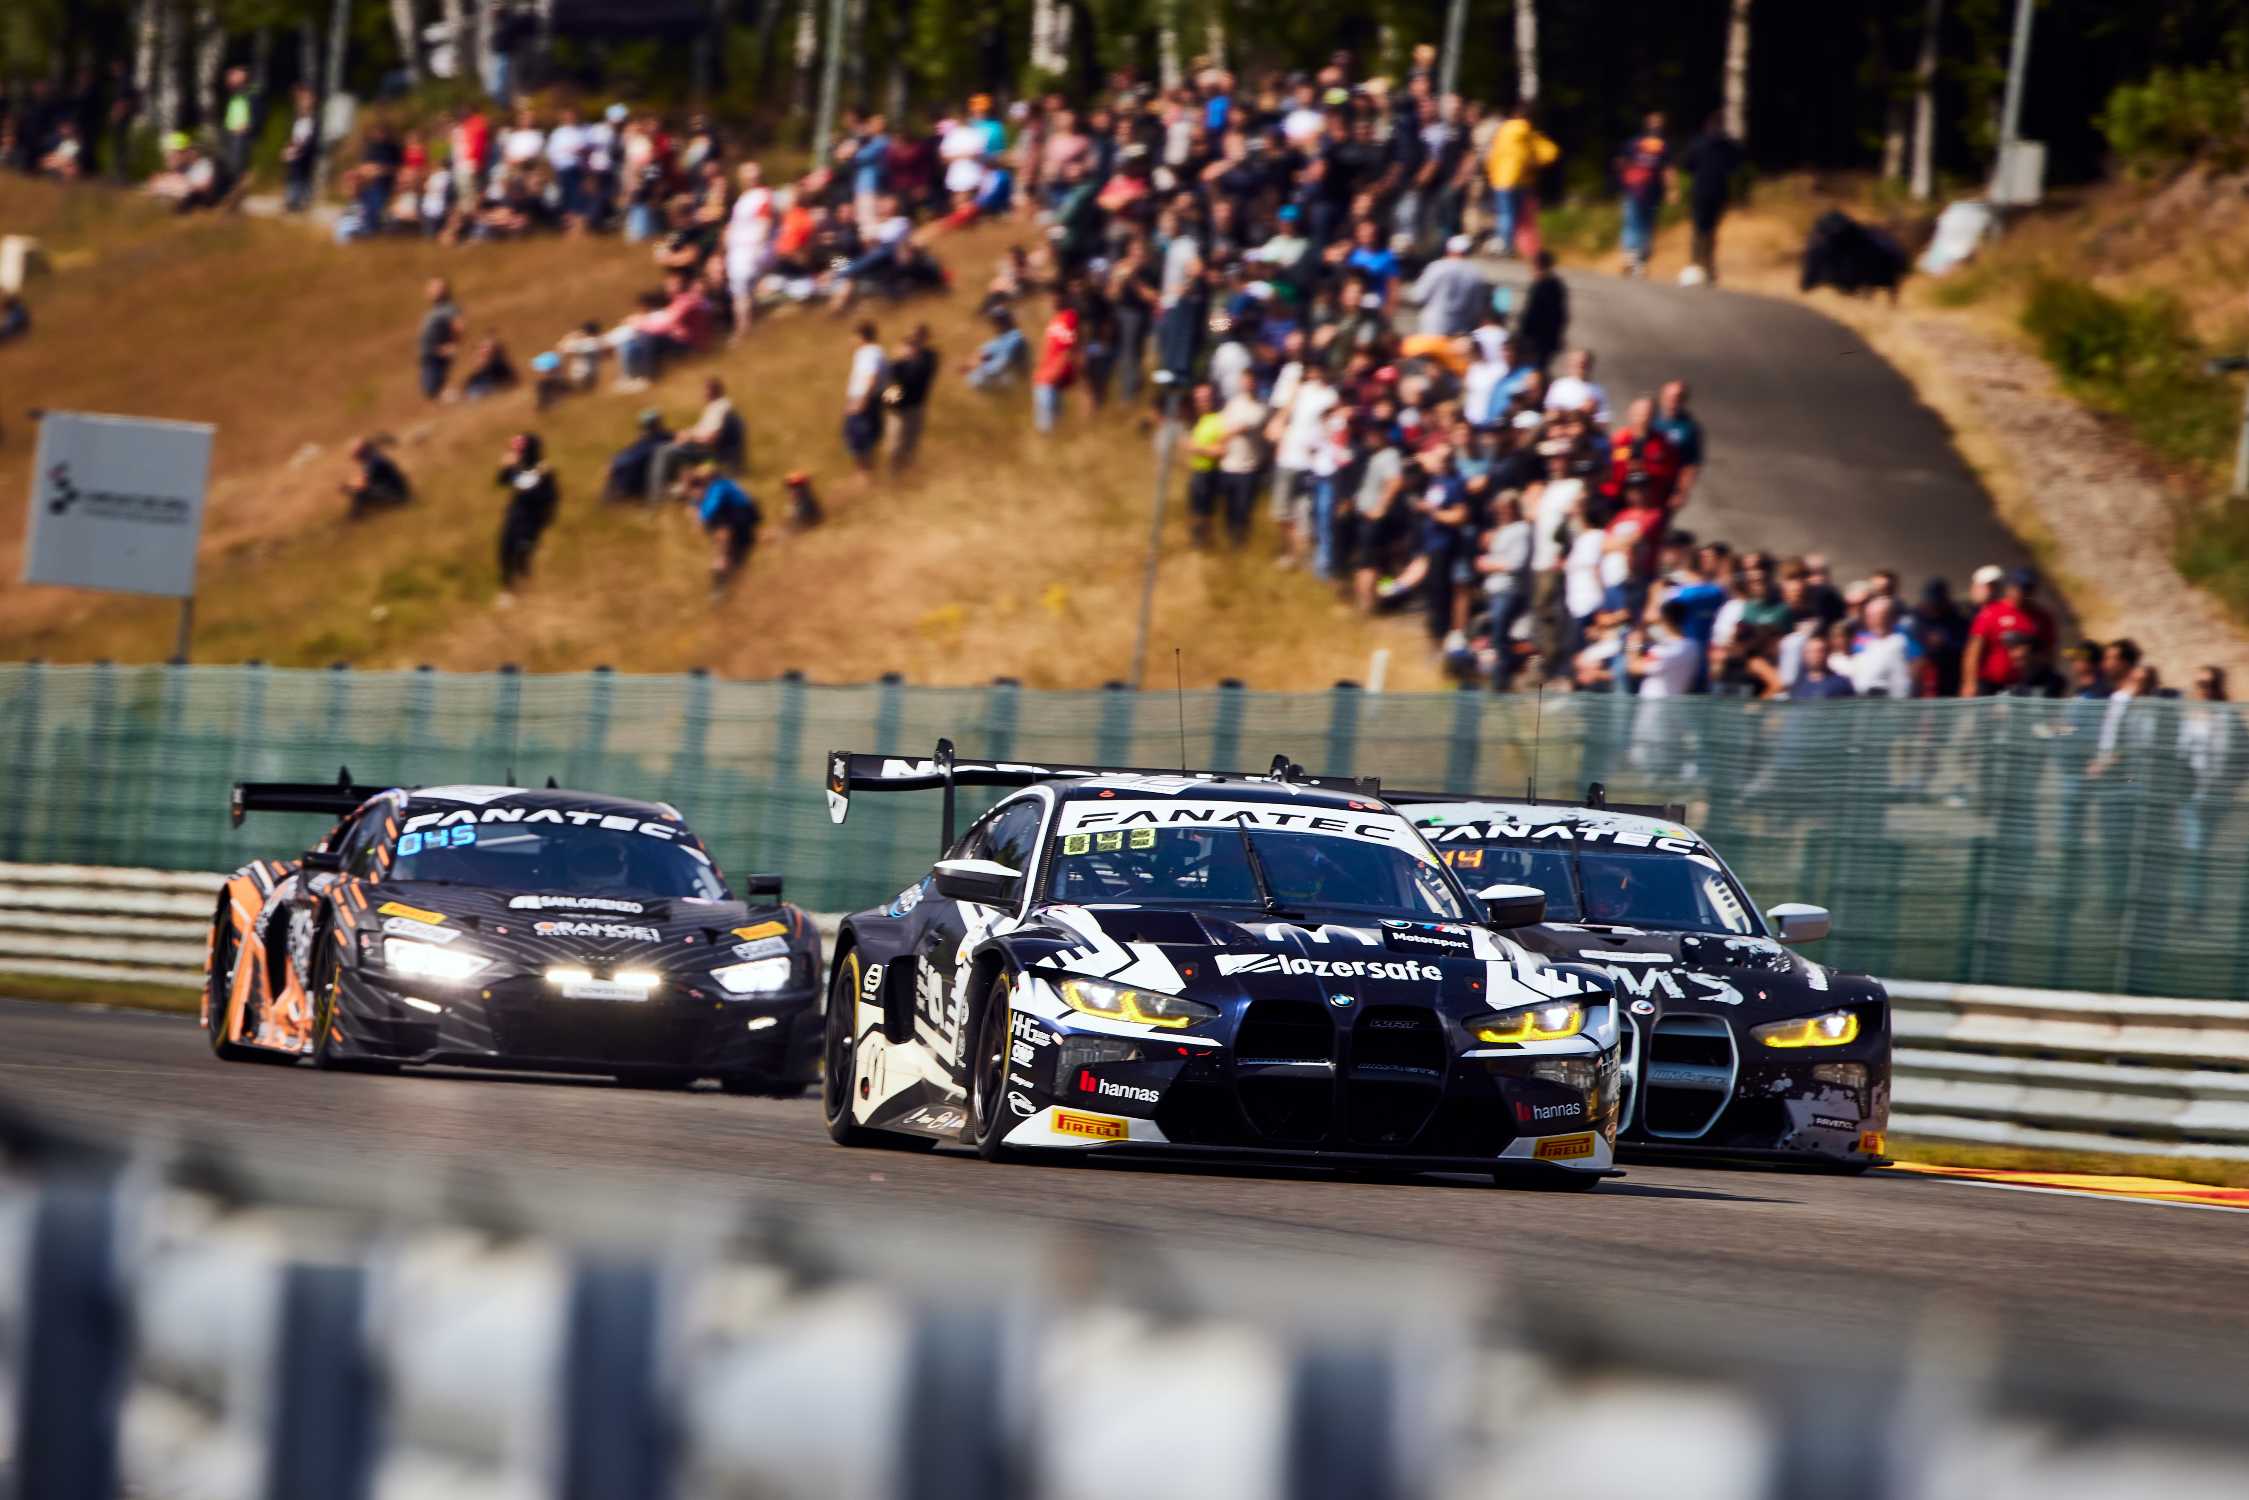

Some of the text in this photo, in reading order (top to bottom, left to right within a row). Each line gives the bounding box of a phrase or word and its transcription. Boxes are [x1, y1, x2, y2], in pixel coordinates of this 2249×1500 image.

[401, 808, 678, 840] FANATEC
[1075, 804, 1395, 841] FANATEC
[397, 824, 477, 856] 045
[1392, 932, 1470, 949] Motorsport
[1277, 954, 1444, 981] lazersafe
[1098, 1078, 1160, 1103] hannas
[1533, 1102, 1581, 1120] hannas
[1057, 1113, 1121, 1138] PIRELLI
[1536, 1136, 1591, 1157] PIRELLI
